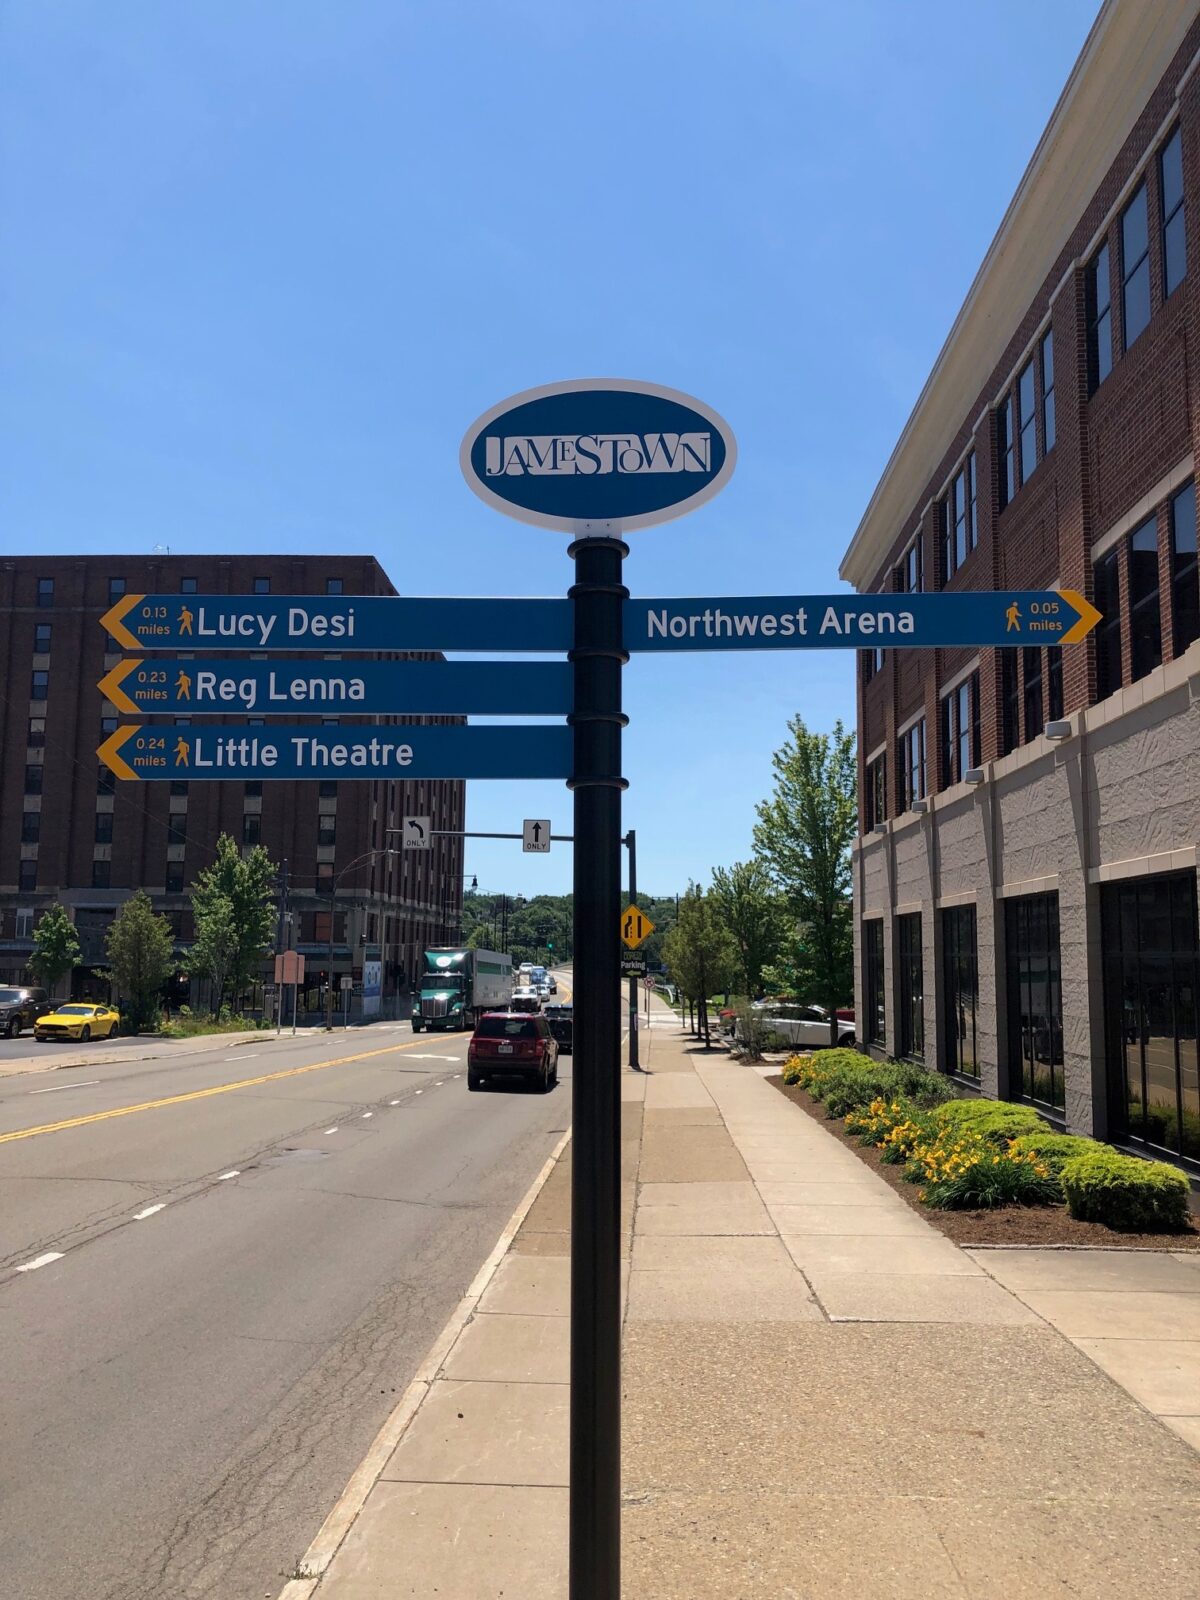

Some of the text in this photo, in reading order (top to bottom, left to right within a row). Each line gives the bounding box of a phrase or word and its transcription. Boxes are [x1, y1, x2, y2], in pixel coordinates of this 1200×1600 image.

[485, 432, 711, 476] JAMESTOWN
[142, 606, 167, 618] 0.13
[1030, 602, 1060, 614] 0.05
[198, 607, 355, 645] Lucy Desi
[647, 607, 915, 638] Northwest Arena
[1029, 619, 1063, 631] miles
[137, 623, 171, 635] miles
[137, 671, 167, 683] 0.23
[135, 688, 168, 700] miles
[196, 672, 365, 708] Reg Lenna
[136, 738, 165, 750] 0.24
[195, 737, 414, 767] Little Theatre
[133, 755, 166, 766] miles
[620, 961, 646, 970] Parking
